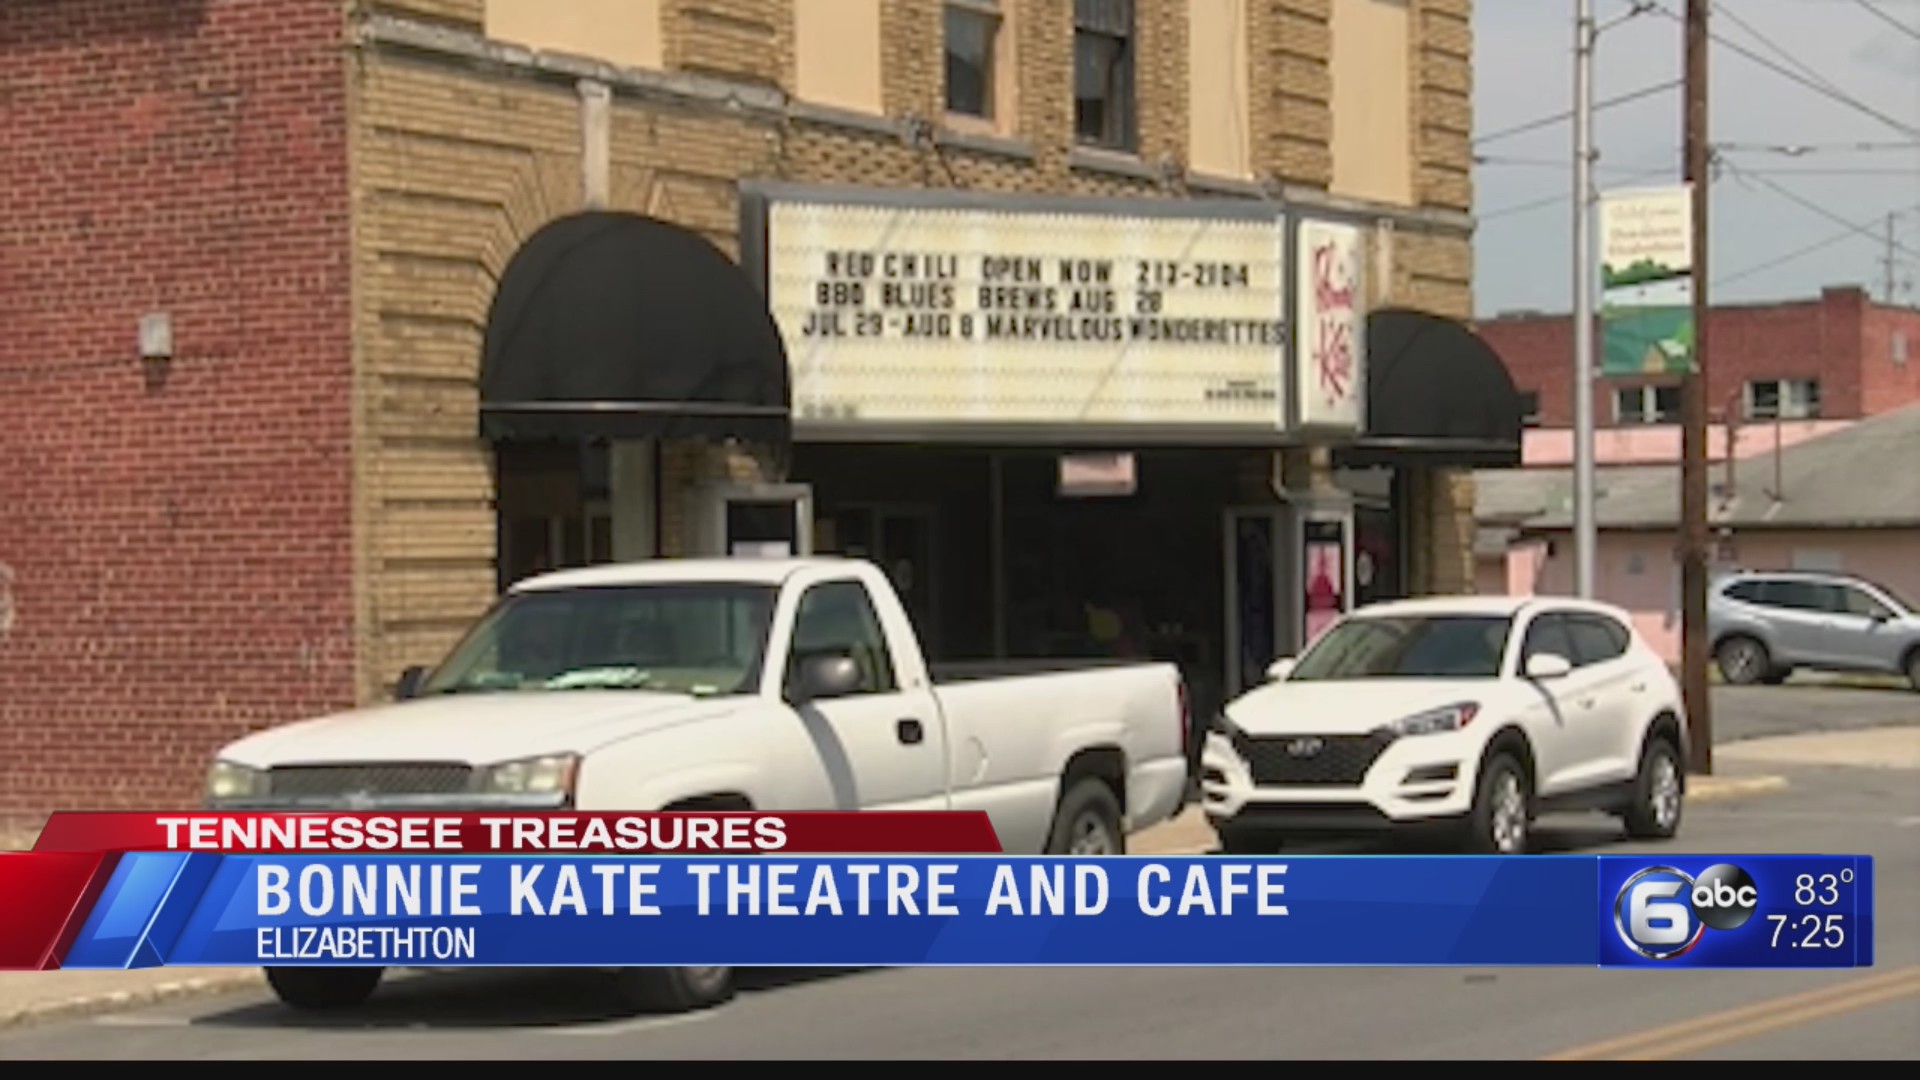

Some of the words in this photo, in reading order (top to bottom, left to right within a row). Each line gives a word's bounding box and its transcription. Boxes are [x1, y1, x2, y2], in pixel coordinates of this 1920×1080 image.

[826, 251, 875, 279] RED
[883, 252, 957, 279] CHILI
[981, 256, 1042, 282] OPEN
[1059, 259, 1113, 284] NOW
[881, 283, 955, 309] BLUES
[978, 286, 1056, 313] BREWS
[1069, 291, 1117, 314] AUG
[802, 313, 847, 337] JUL
[986, 316, 1122, 342] MARVELOUS
[1128, 318, 1286, 345] WONDERETTES
